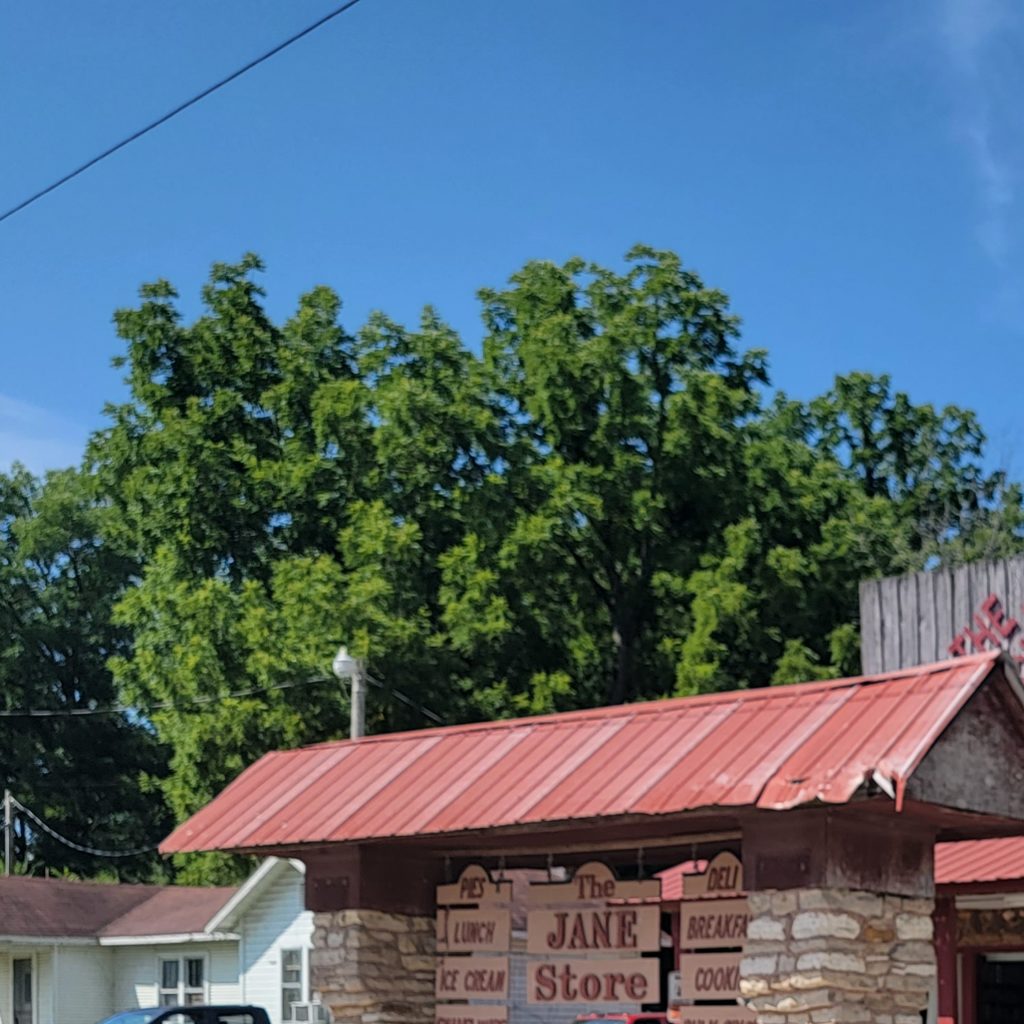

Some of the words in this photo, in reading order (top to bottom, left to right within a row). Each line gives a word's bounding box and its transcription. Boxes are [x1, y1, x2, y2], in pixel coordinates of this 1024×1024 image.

[460, 876, 486, 899] PIES
[577, 874, 615, 899] The
[707, 865, 739, 891] DELI
[454, 921, 496, 943] LUNCH
[546, 910, 638, 949] JANE
[687, 913, 753, 940] BREAKFA
[464, 969, 506, 992] CREAM
[535, 963, 648, 1001] Store
[695, 966, 741, 991] COOKI
